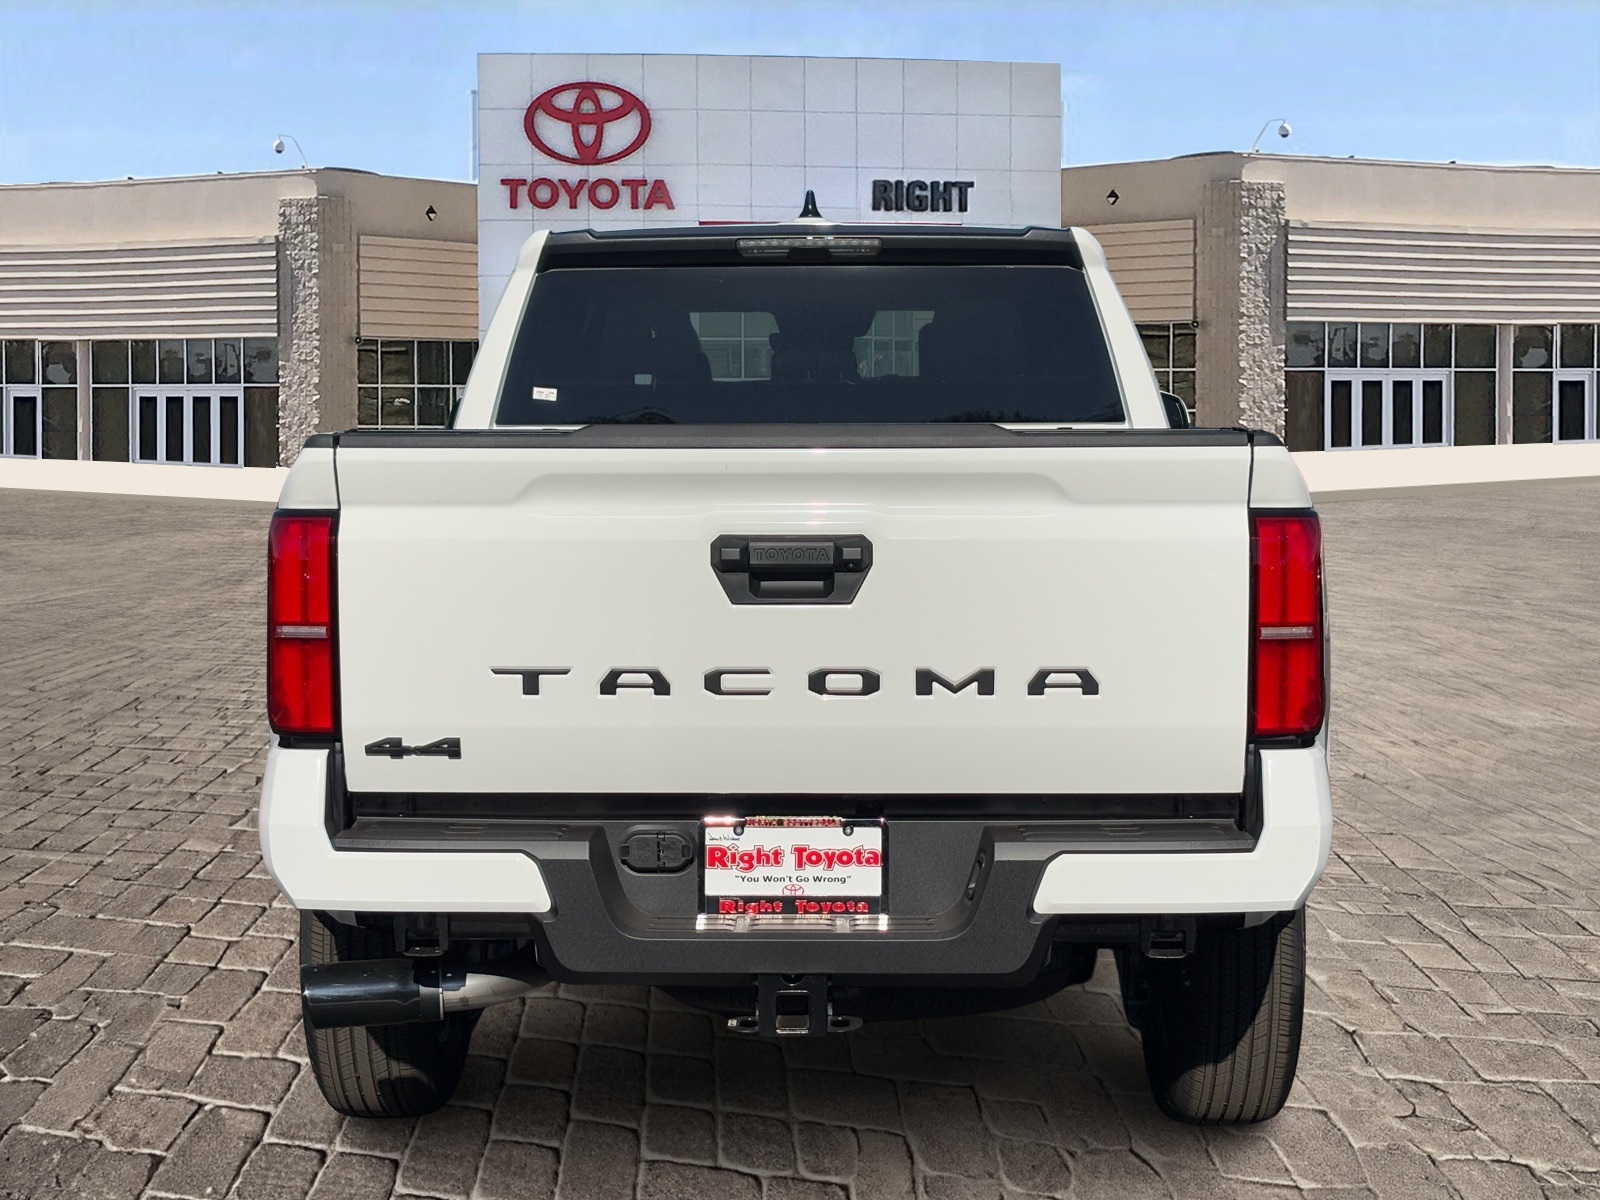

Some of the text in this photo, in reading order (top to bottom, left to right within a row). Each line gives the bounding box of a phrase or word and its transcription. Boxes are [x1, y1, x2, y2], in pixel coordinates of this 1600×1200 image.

[500, 178, 675, 211] TOYOTA
[871, 179, 975, 213] RIGHT
[754, 547, 829, 561] TOYOTA
[490, 666, 1101, 697] TACOMA
[706, 843, 884, 873] Right Toyota
[795, 875, 810, 884] Go
[718, 899, 869, 915] Right Toyota
